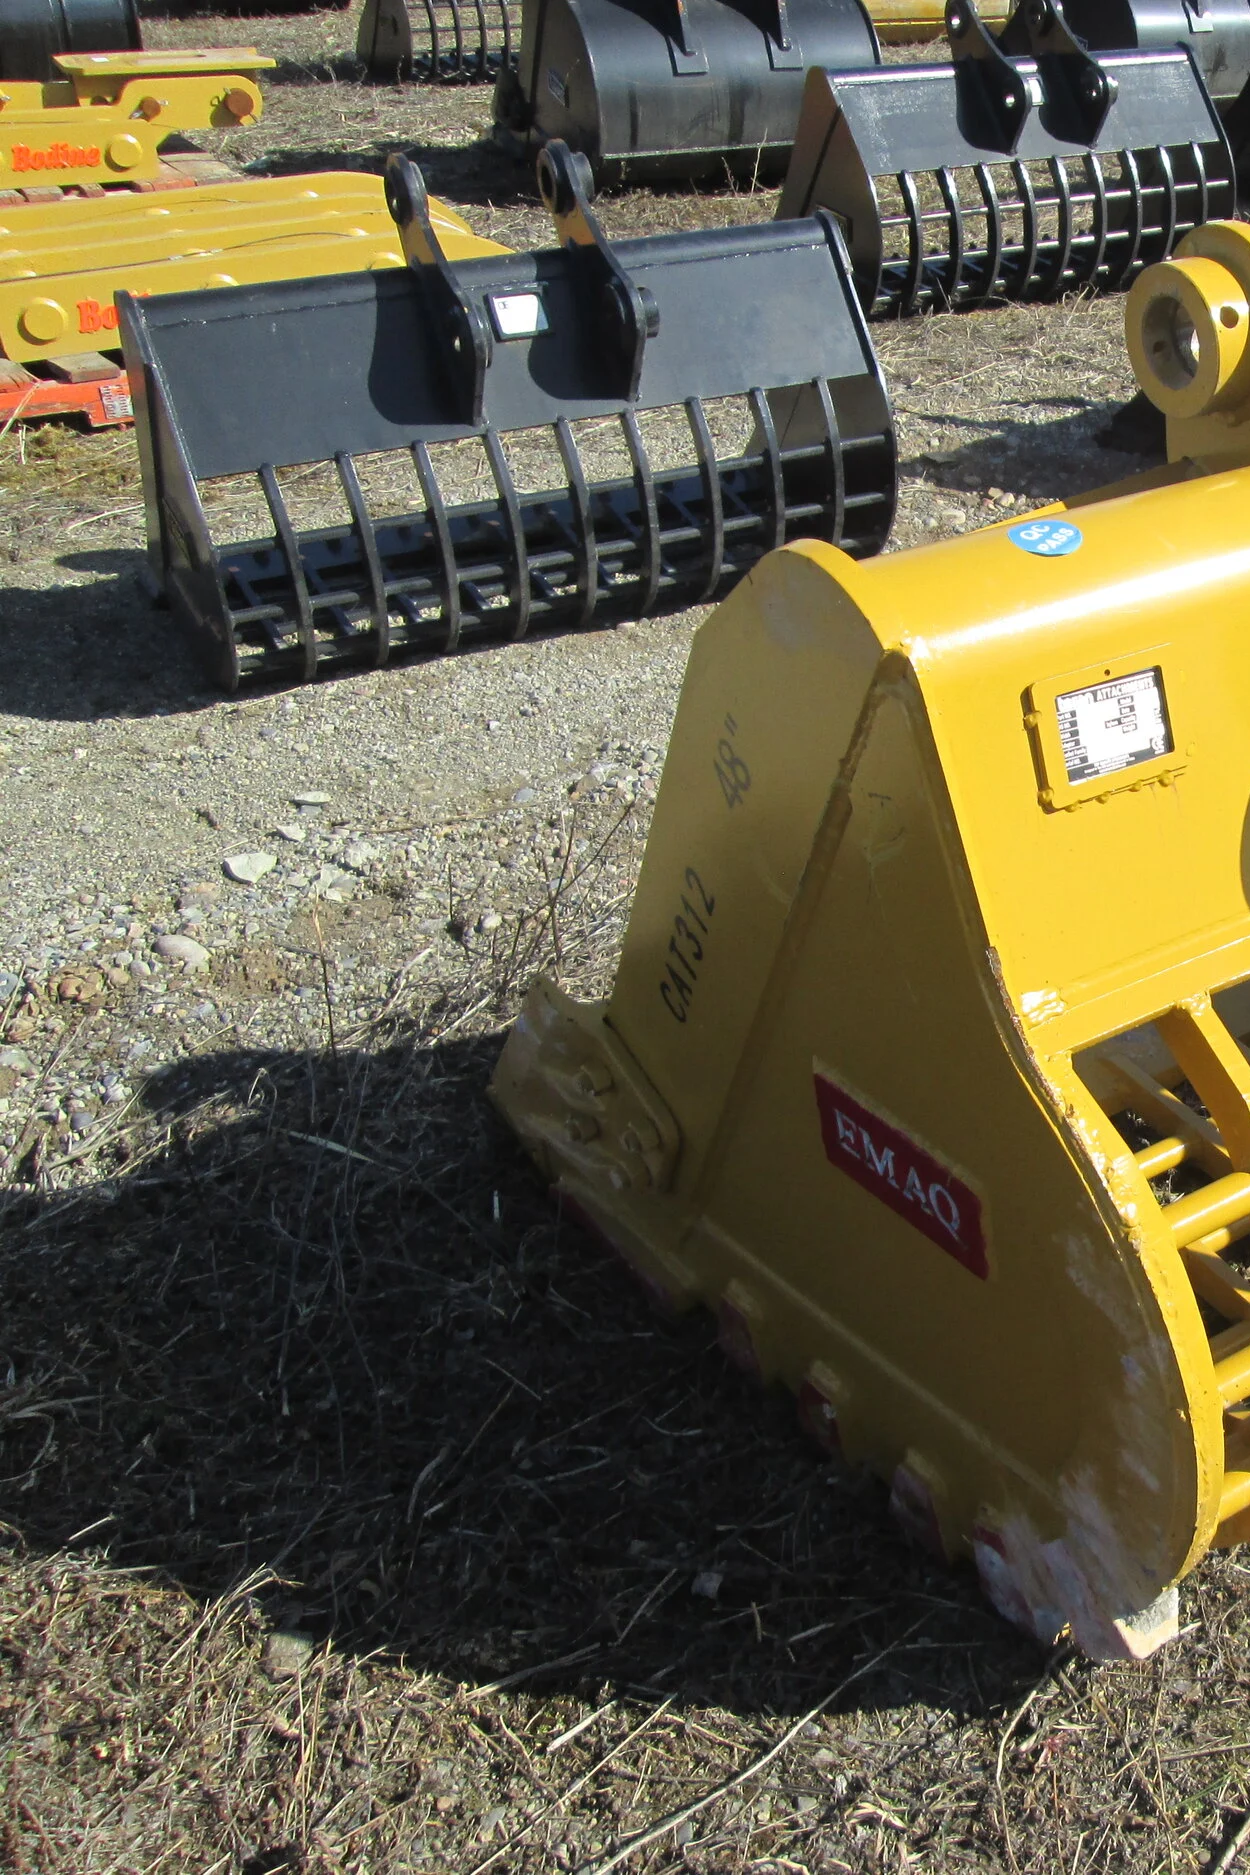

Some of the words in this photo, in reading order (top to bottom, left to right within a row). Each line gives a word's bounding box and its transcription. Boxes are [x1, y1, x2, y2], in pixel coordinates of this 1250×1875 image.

[12, 141, 101, 172] Bodine
[1019, 524, 1050, 540] QC
[1037, 527, 1074, 551] PASS
[660, 867, 715, 1024] CAT312
[834, 1108, 968, 1250] EMAQ
